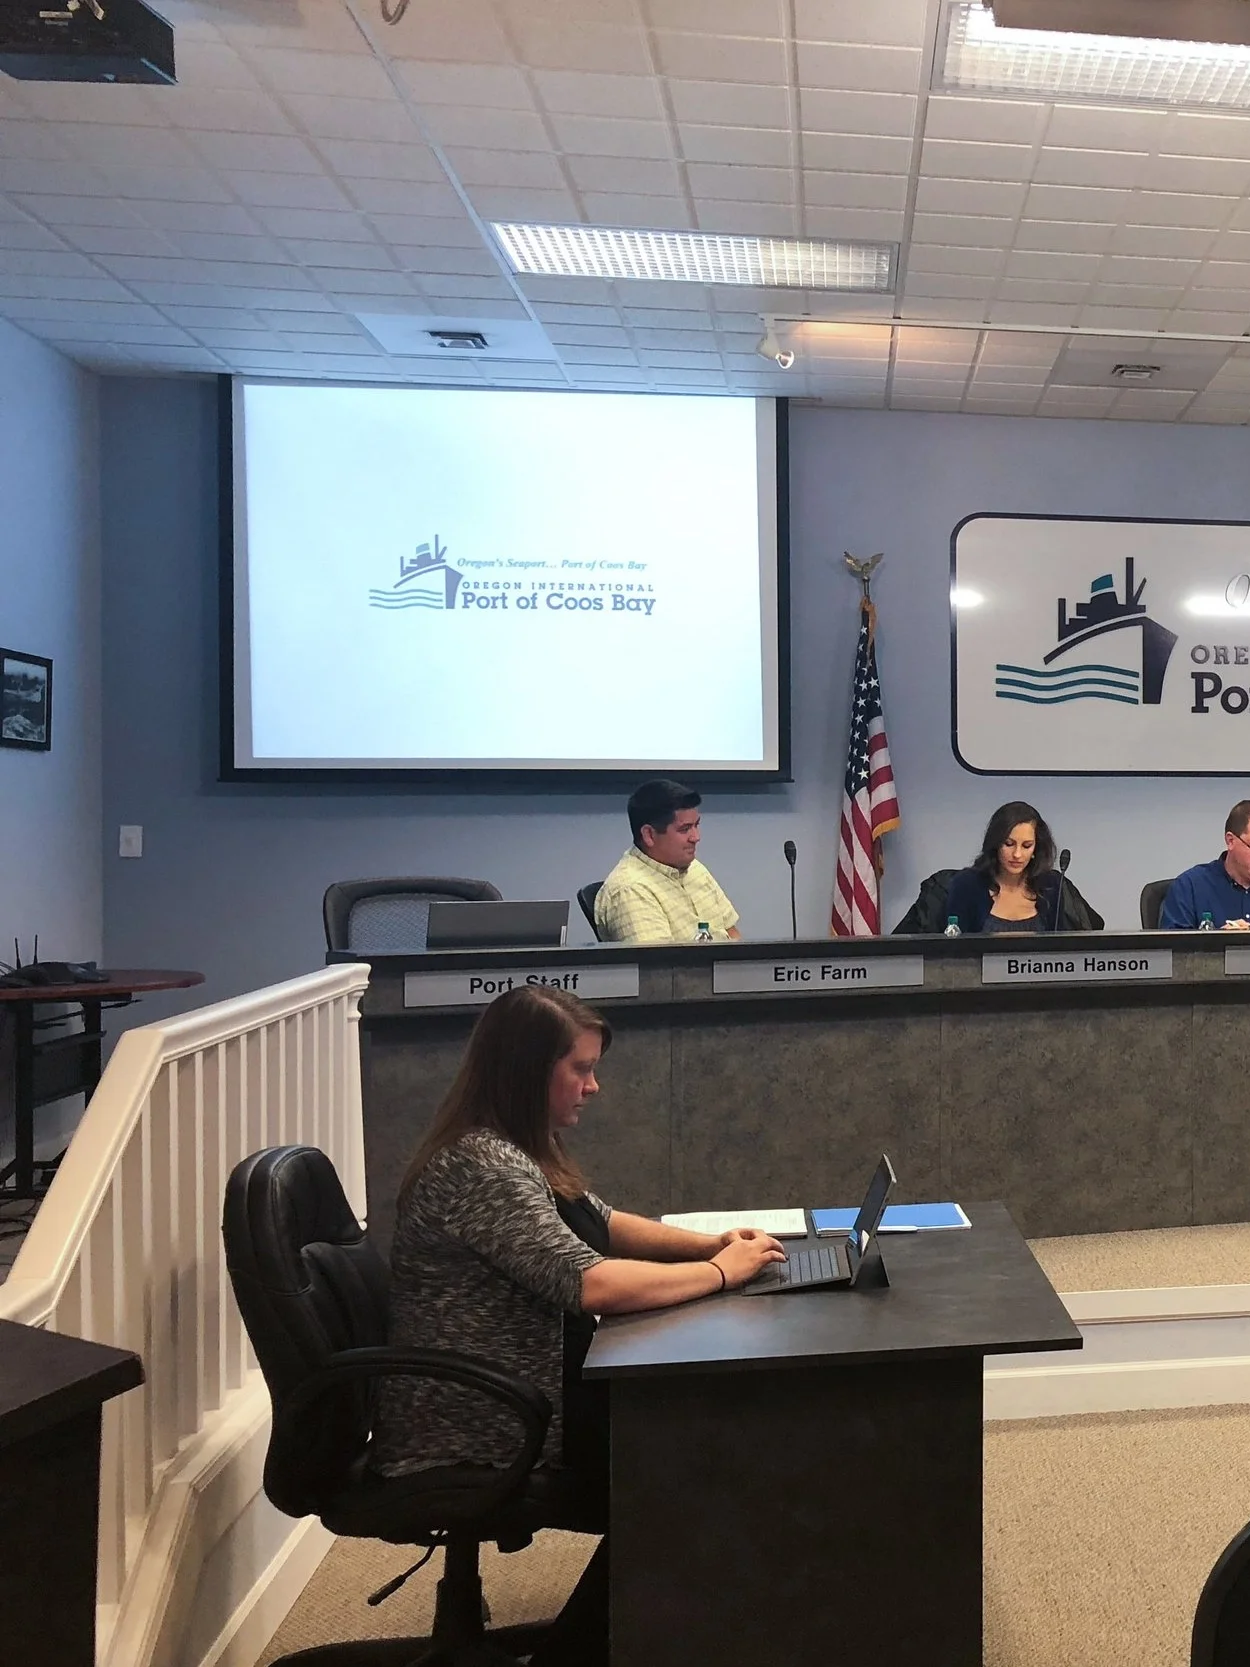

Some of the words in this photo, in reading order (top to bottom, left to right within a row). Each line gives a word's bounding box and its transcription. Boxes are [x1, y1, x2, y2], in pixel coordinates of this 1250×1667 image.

[585, 559, 597, 571] of
[628, 561, 648, 572] Bay
[462, 581, 522, 590] OREGON
[531, 582, 654, 592] INTERNATIONAL
[461, 591, 508, 609] Port
[516, 592, 538, 610] of
[546, 592, 604, 610] Coos
[611, 594, 656, 616] Bay
[772, 964, 811, 983] Eric
[820, 964, 868, 981] Farm
[1006, 957, 1076, 975] Brianna
[1082, 956, 1149, 973] Hanson
[469, 977, 513, 994] Port
